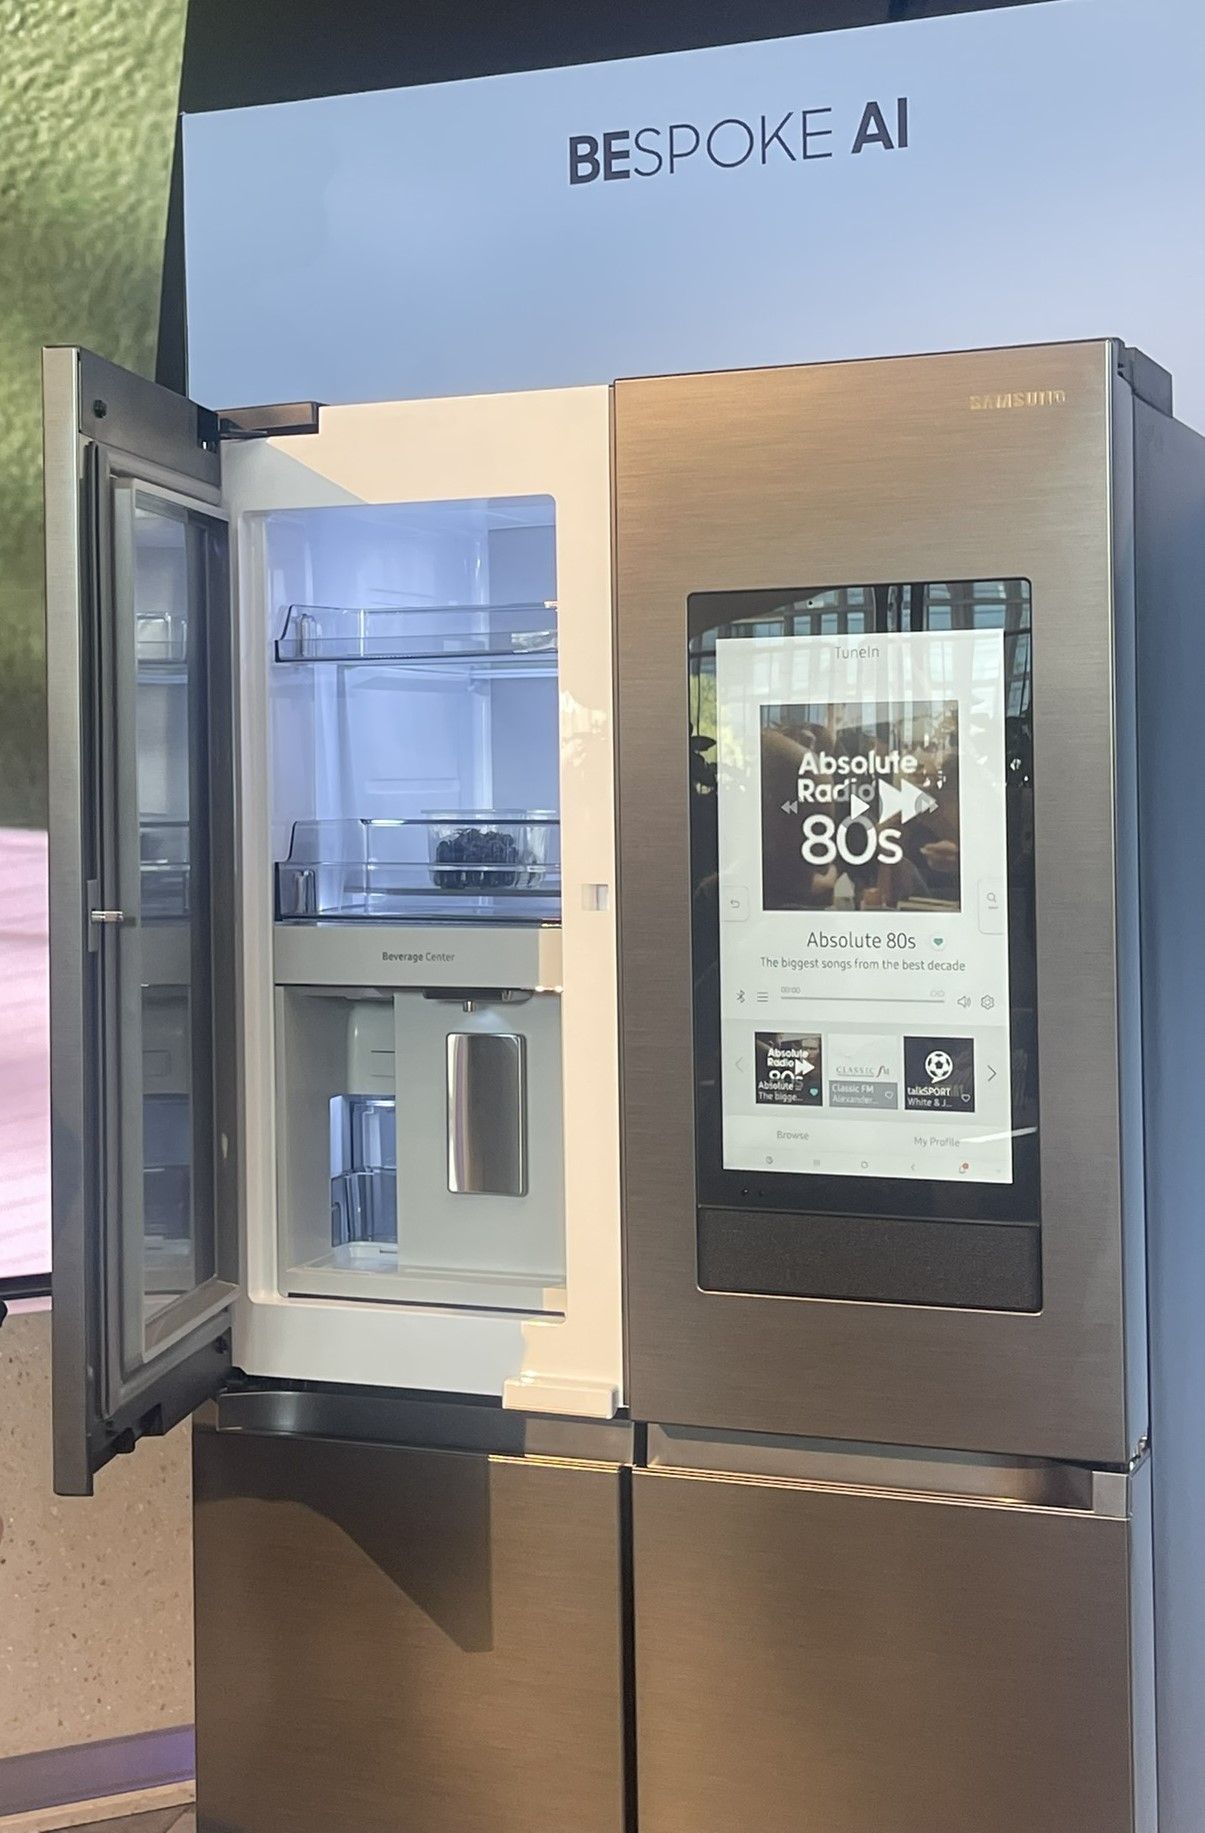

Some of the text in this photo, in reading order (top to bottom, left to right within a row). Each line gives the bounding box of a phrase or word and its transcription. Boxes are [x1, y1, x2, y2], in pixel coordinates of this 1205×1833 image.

[569, 97, 908, 185] BESPOKE AI
[835, 646, 880, 659] TuneIn
[799, 750, 918, 775] Absolute
[798, 778, 875, 803] Radio
[801, 814, 903, 865] 80s
[807, 932, 916, 949] Absolute 80s
[382, 951, 455, 963] Beverage Center
[760, 957, 966, 972] The biggest songs from the best decade
[767, 1048, 809, 1058] Absolute
[767, 1057, 795, 1067] Radio
[758, 1081, 794, 1090] Absolute
[832, 1083, 874, 1093] Classic FM
[907, 1086, 951, 1096] talkSPORT
[758, 1091, 773, 1100] The
[907, 1097, 932, 1106] White
[933, 1098, 940, 1107] &
[776, 1130, 810, 1141] Browse
[914, 1136, 960, 1148] My Profile
